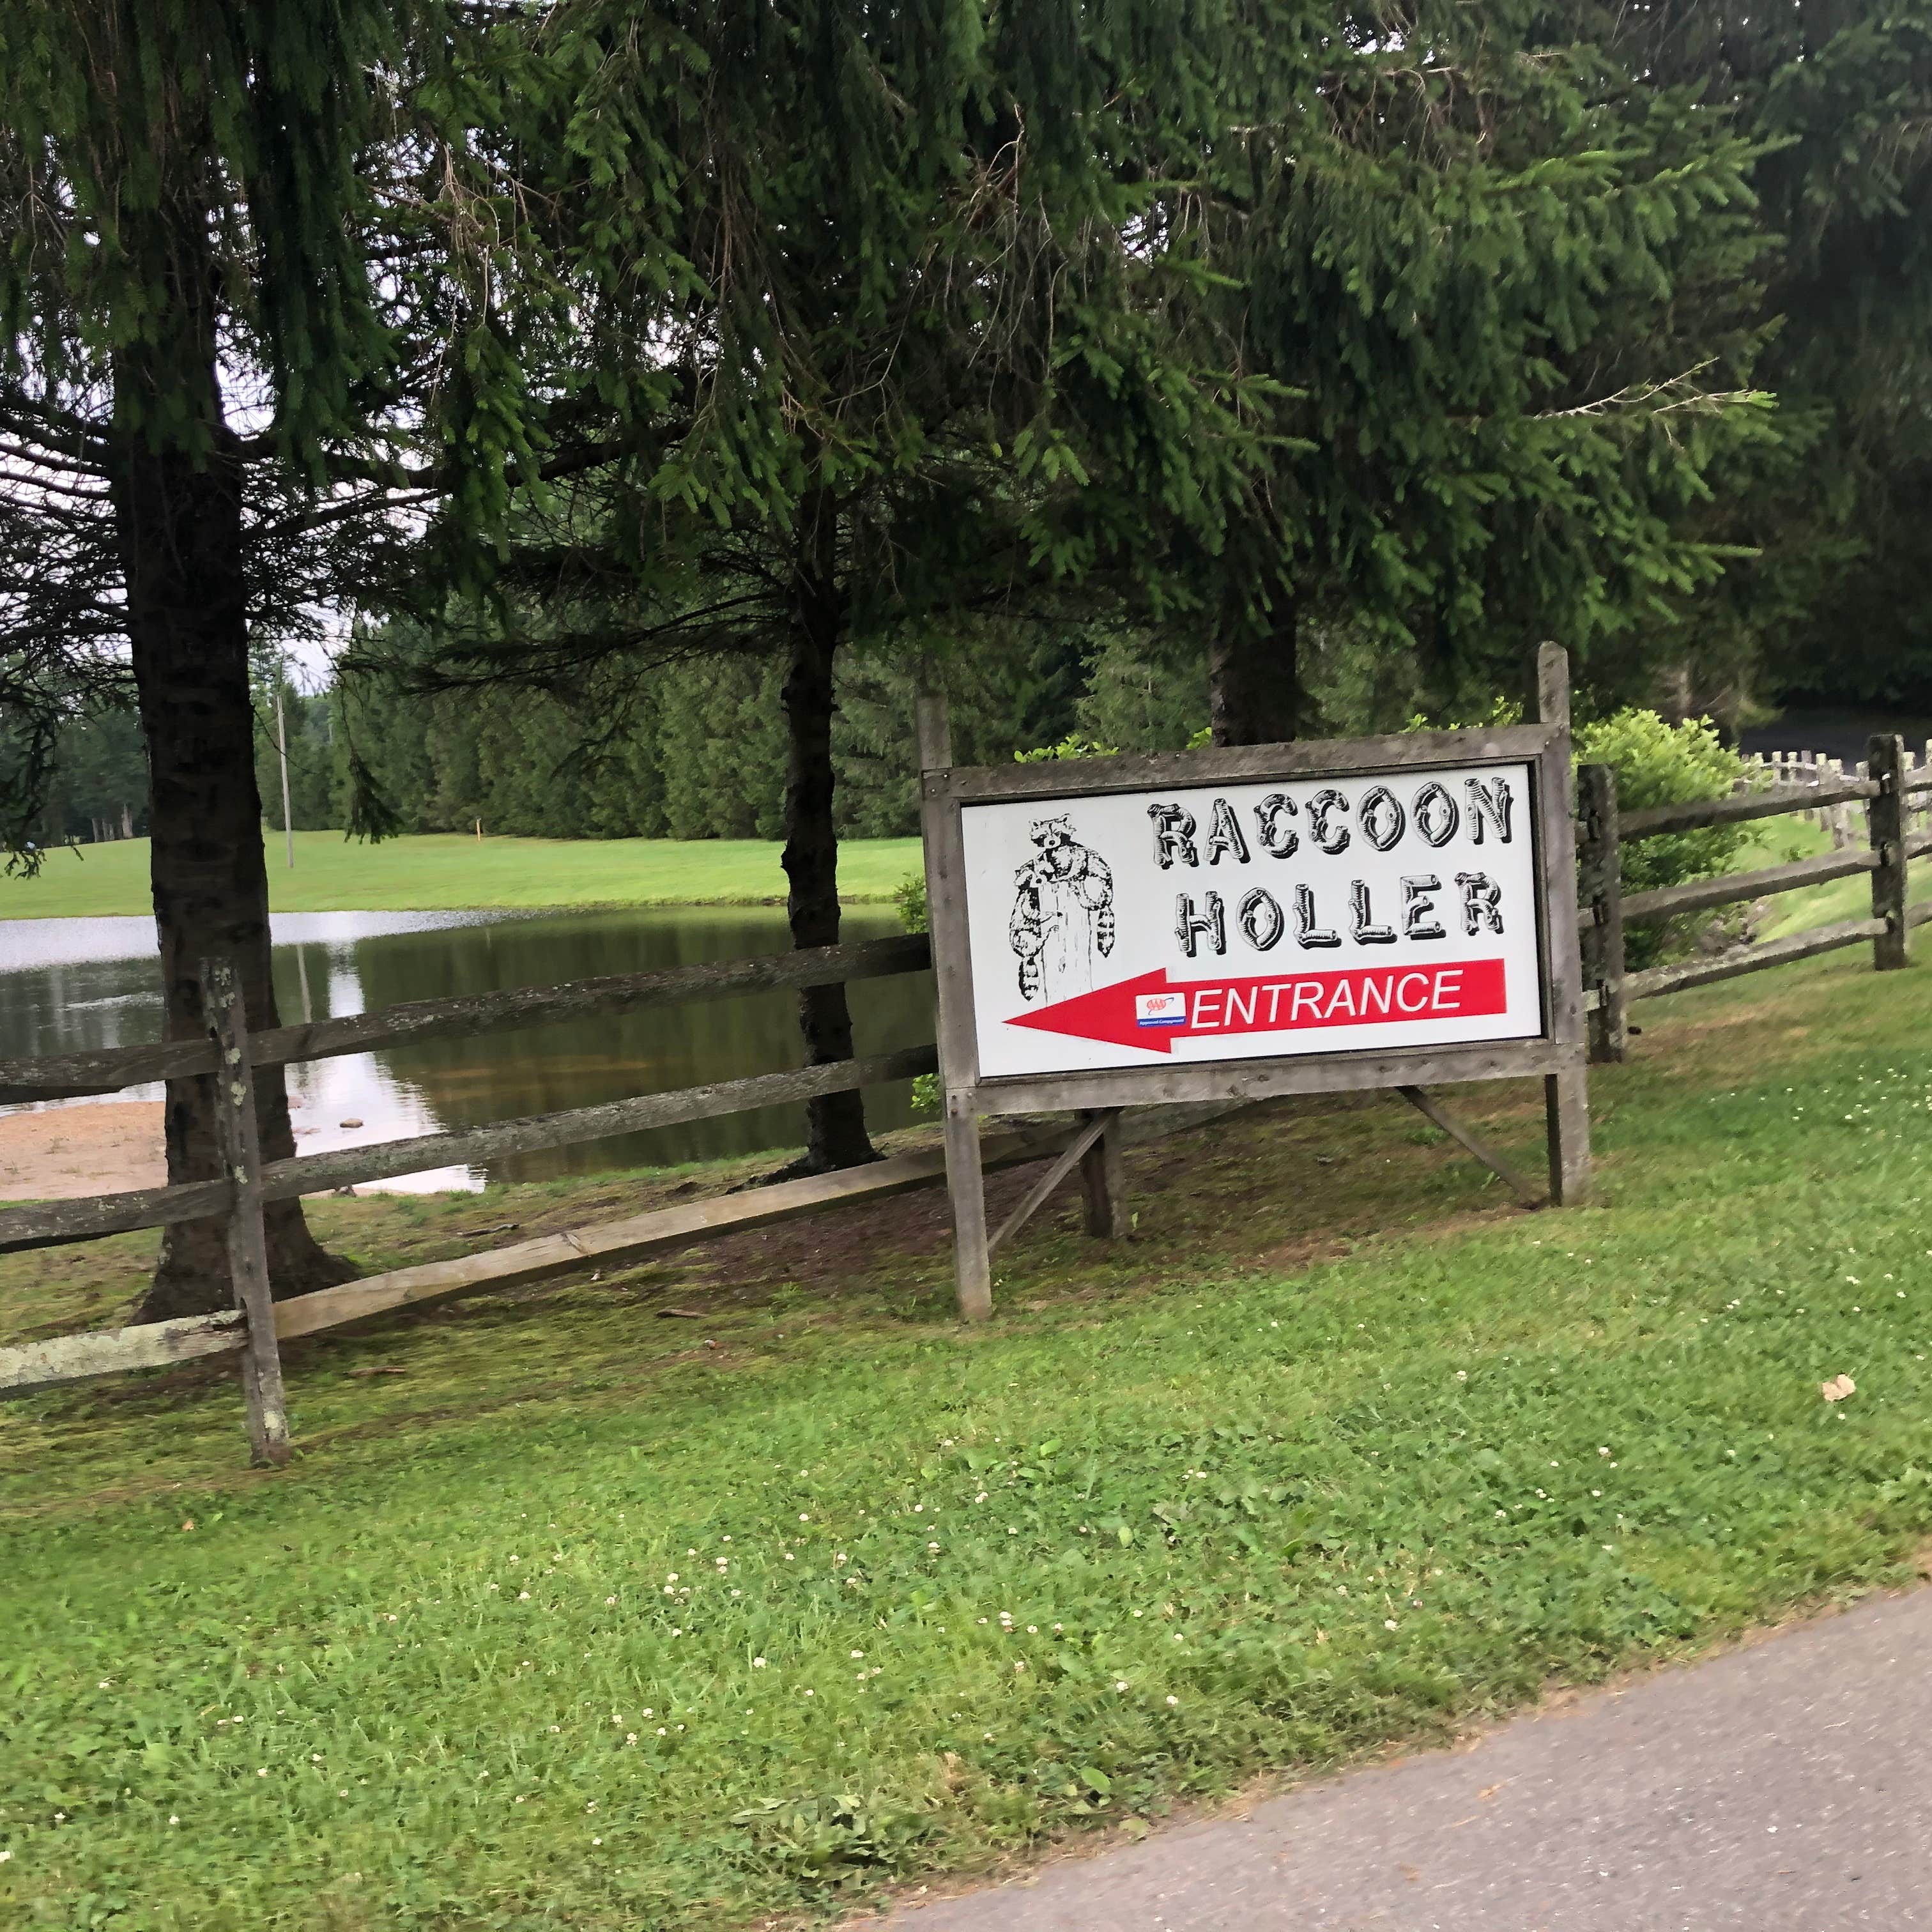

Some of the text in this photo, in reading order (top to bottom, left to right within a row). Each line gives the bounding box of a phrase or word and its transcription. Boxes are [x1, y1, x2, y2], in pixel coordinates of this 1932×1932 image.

[1147, 777, 1514, 870] RACCOON
[1174, 872, 1504, 957] HOLLER
[1190, 970, 1464, 1029] ENTRANCE
